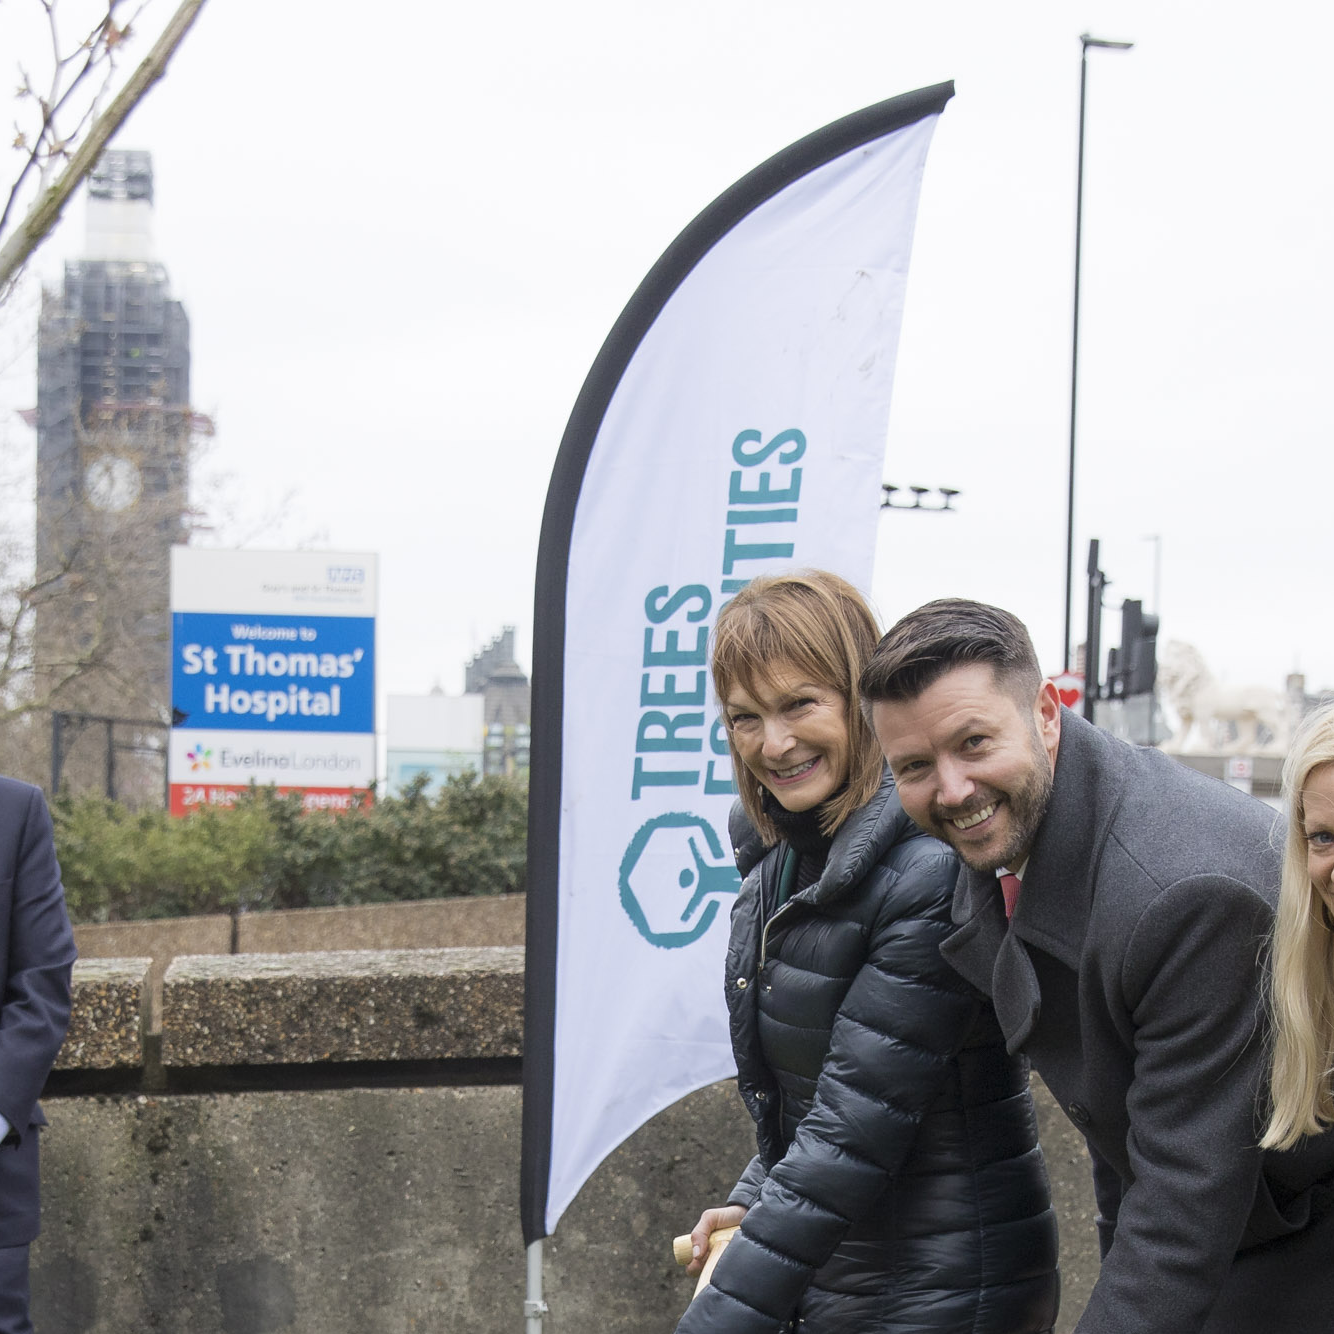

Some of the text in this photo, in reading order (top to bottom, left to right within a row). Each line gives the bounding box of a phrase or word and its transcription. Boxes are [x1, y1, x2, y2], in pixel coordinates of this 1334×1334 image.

[231, 624, 317, 642] Welcome to
[182, 643, 218, 675] St
[205, 684, 340, 721] Hospital
[632, 584, 712, 801] TREES
